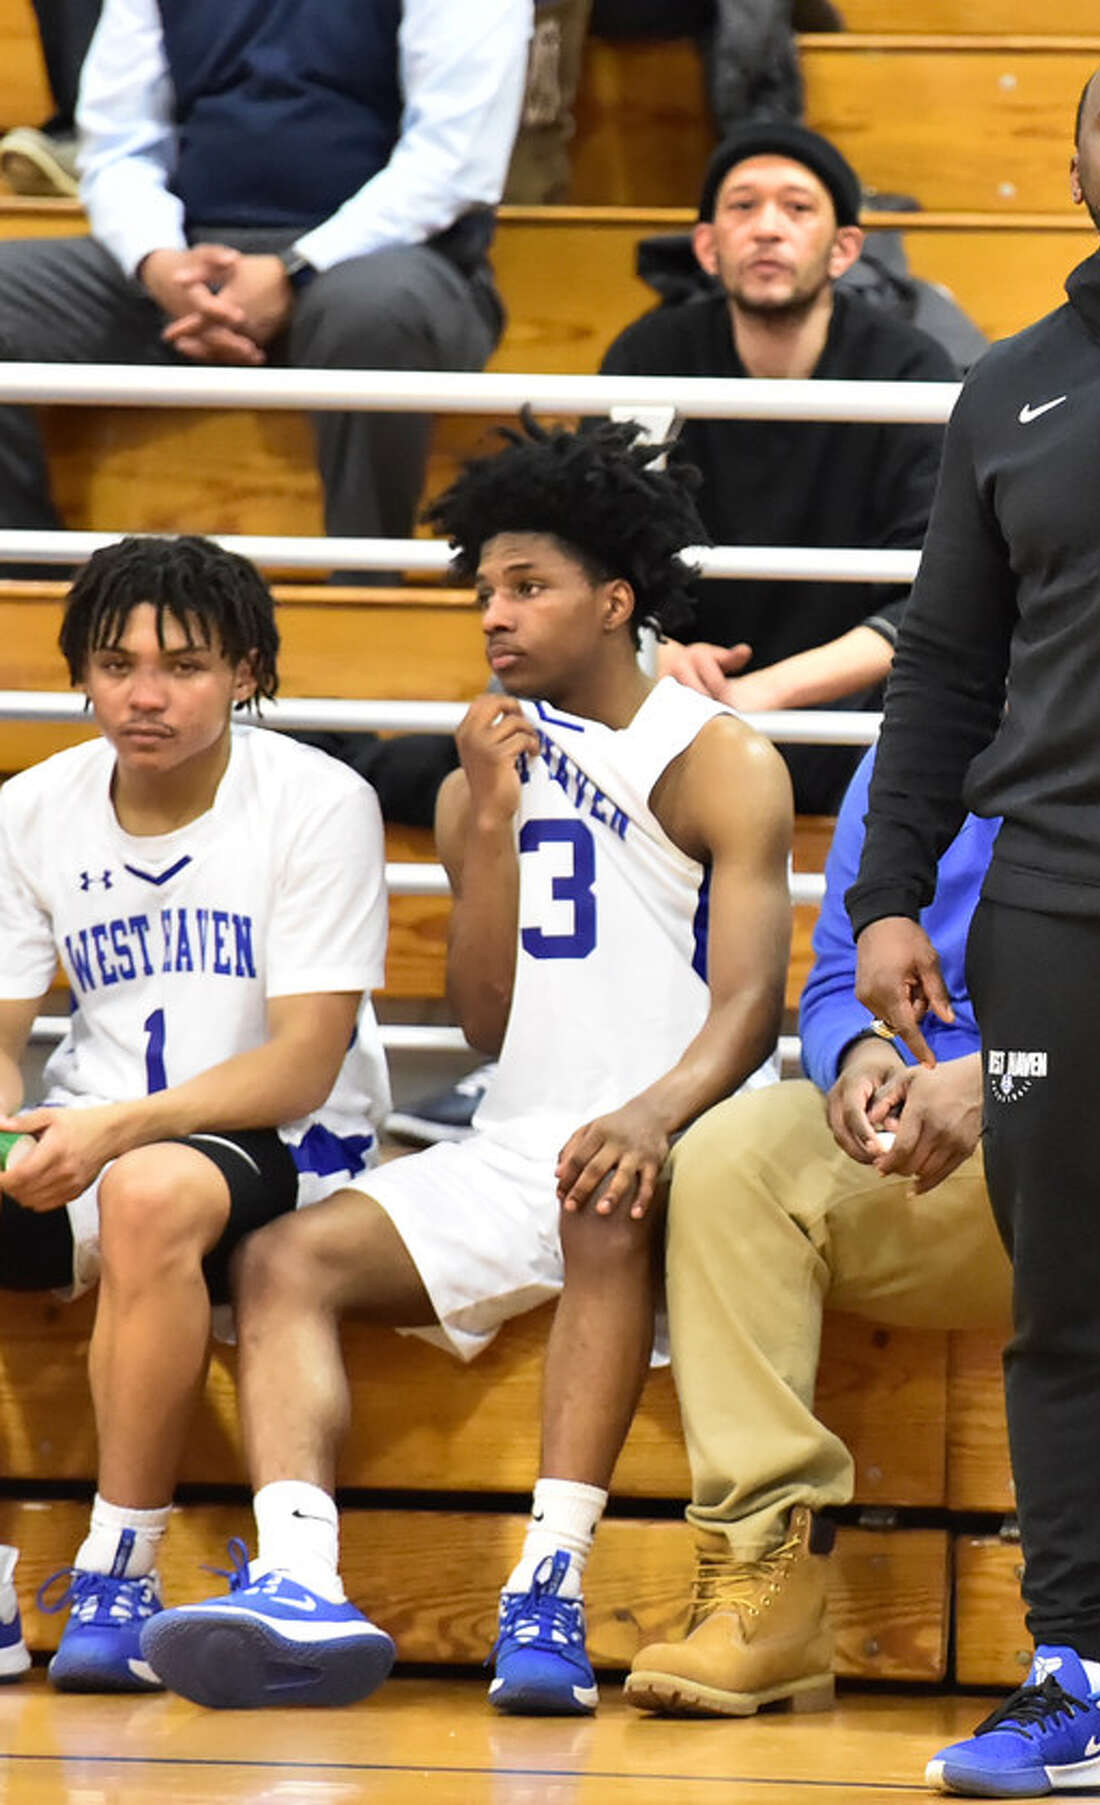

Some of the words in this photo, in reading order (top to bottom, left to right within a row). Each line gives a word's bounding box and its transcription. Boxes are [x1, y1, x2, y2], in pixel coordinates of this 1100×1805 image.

[519, 818, 597, 960] 3
[65, 914, 154, 993] WEST
[160, 908, 257, 979] HAVEN
[143, 1008, 169, 1096] 1
[1006, 1051, 1048, 1077] HAVEN
